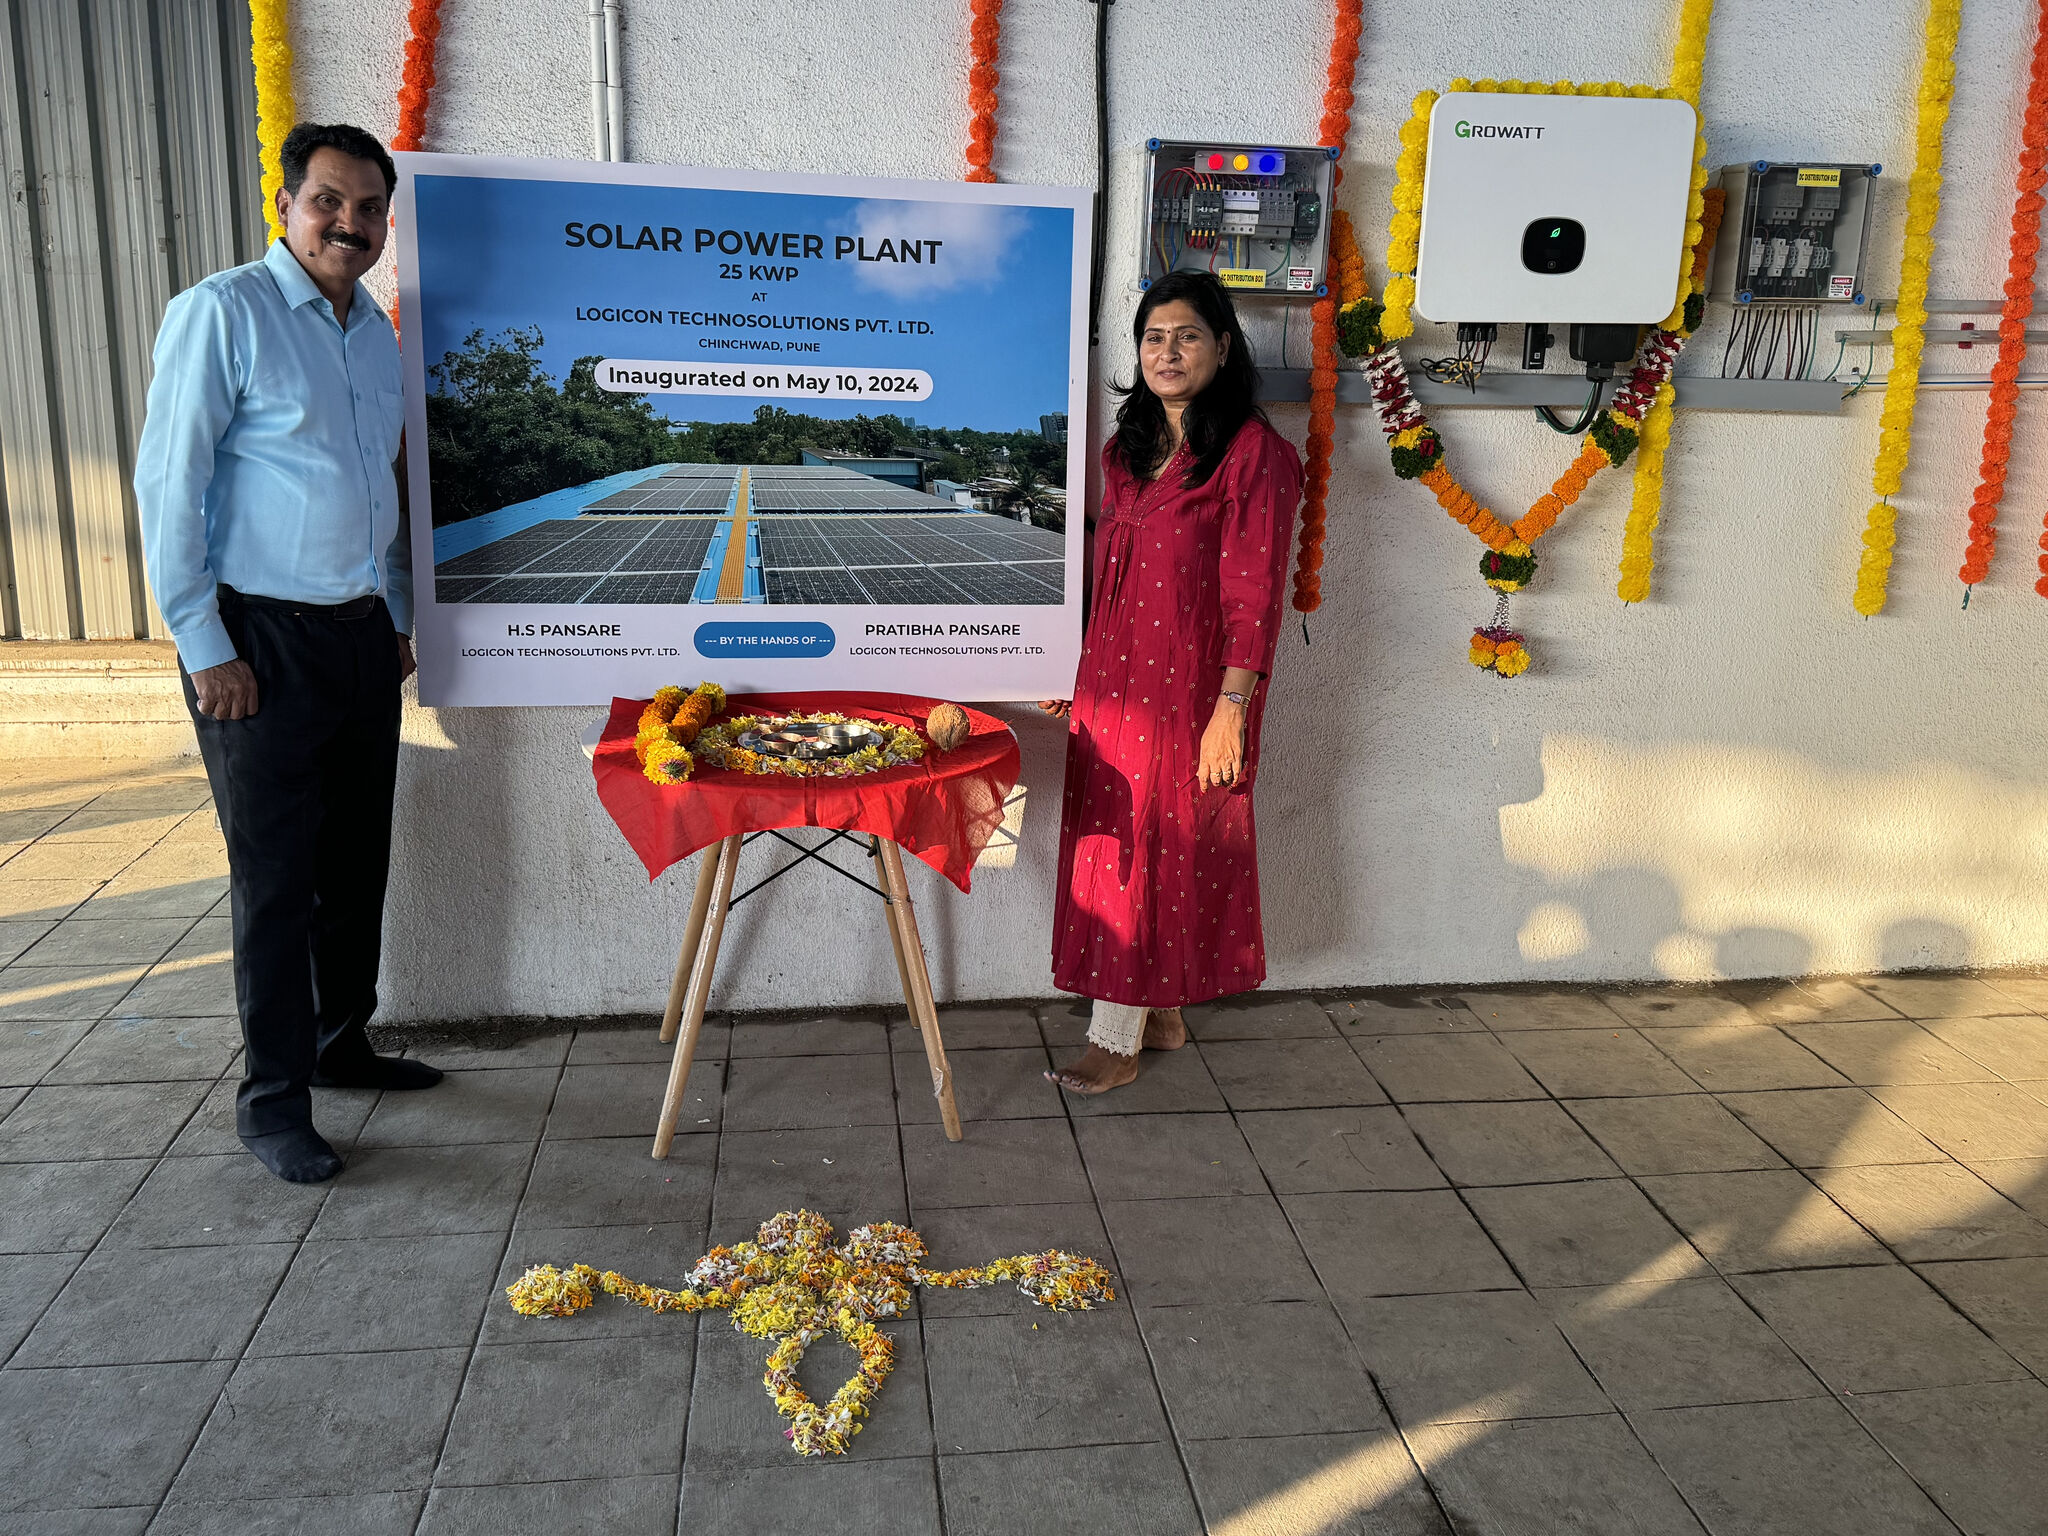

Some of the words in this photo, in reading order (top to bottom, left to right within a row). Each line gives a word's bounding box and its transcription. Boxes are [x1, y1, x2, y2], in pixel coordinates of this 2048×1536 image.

[1455, 121, 1545, 139] GROWATT
[1830, 174, 1838, 182] BOX
[565, 222, 682, 252] SOLAR
[695, 229, 823, 259] POWER
[836, 236, 942, 264] PLANT
[720, 264, 742, 279] 25
[750, 265, 798, 281] KWP
[1227, 274, 1254, 282] DISTRIBUTION
[1255, 275, 1263, 283] BOX
[752, 293, 767, 302] AT
[577, 307, 662, 323] LOGICON
[668, 311, 849, 331] TECHNOSOLUTIONS
[856, 319, 892, 333] PVT.
[899, 321, 933, 334] LTD.
[699, 339, 782, 352] CHINCHWAD,
[787, 342, 820, 352] PUNE
[609, 367, 746, 391] Inaugurated
[753, 376, 779, 388] on
[788, 374, 830, 393] May
[836, 375, 862, 394] 10,
[869, 376, 919, 392] 2024
[508, 625, 535, 636] H.S
[541, 625, 621, 636] PANSARE
[866, 625, 944, 635] PRATIBHA
[950, 625, 1020, 635] PANSARE
[658, 648, 679, 656] LTD.
